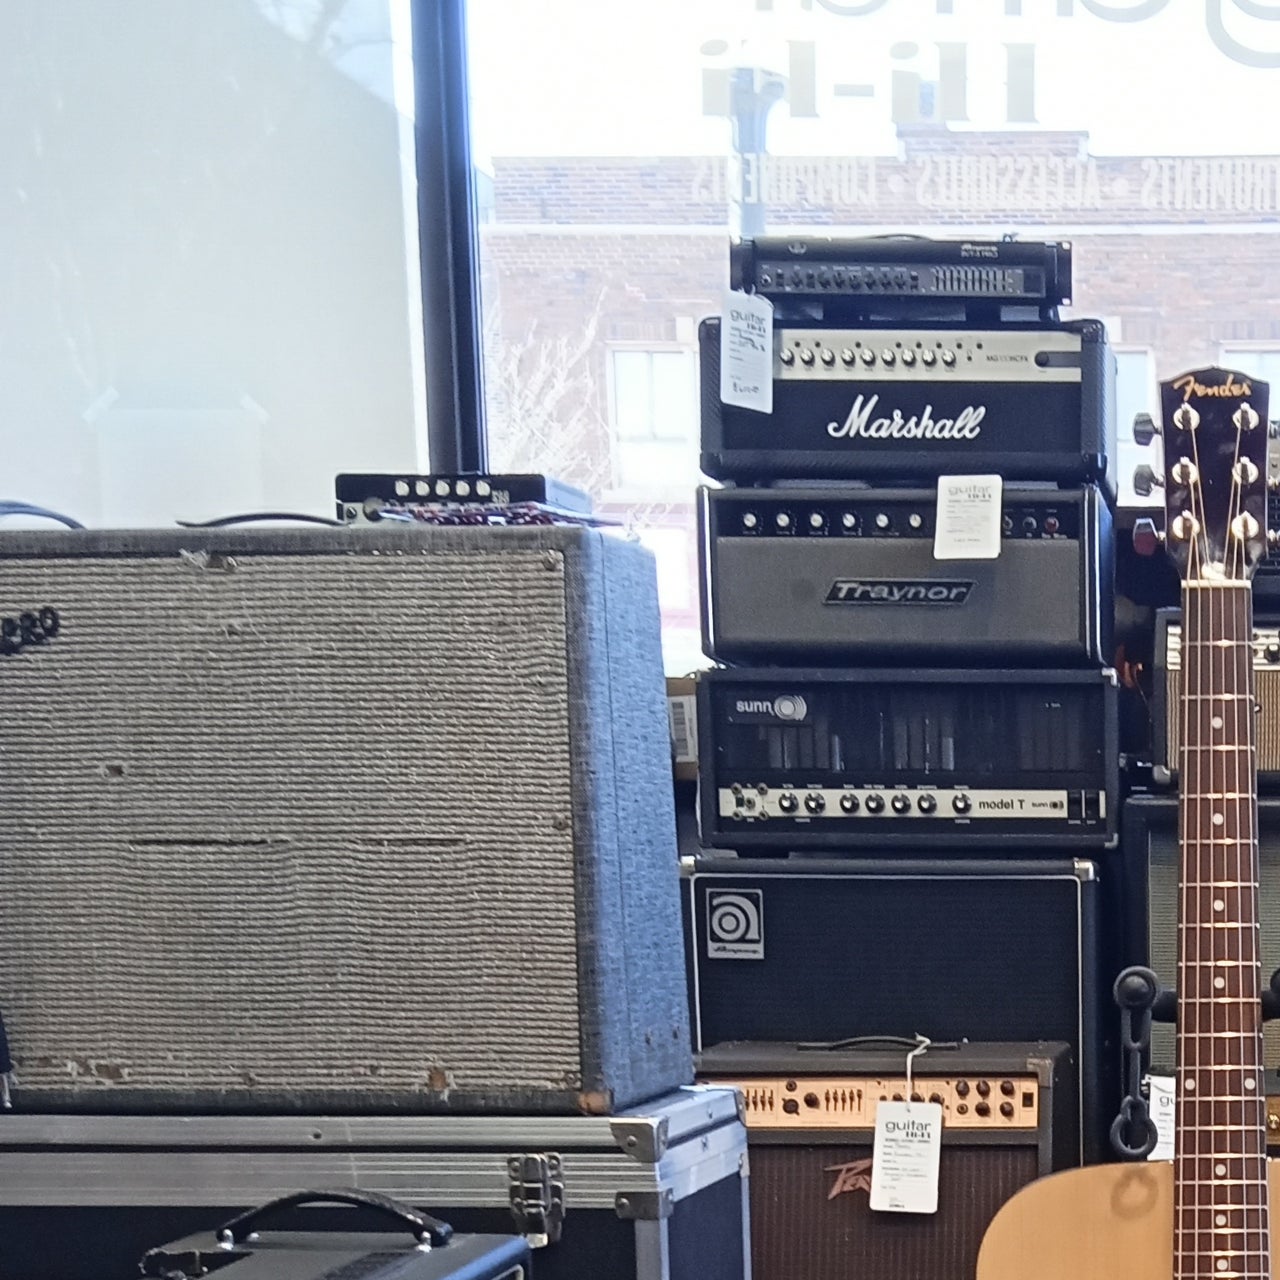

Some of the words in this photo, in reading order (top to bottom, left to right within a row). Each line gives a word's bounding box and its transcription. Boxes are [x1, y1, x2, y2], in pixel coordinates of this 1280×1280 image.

[729, 309, 767, 325] guitar
[1171, 374, 1252, 402] Fender
[827, 393, 986, 440] Marshall
[947, 485, 993, 496] guitar
[835, 580, 967, 604] Traynor
[735, 698, 775, 716] sunn
[978, 798, 1013, 810] model
[1015, 799, 1026, 810] T
[884, 1119, 932, 1134] guitar
